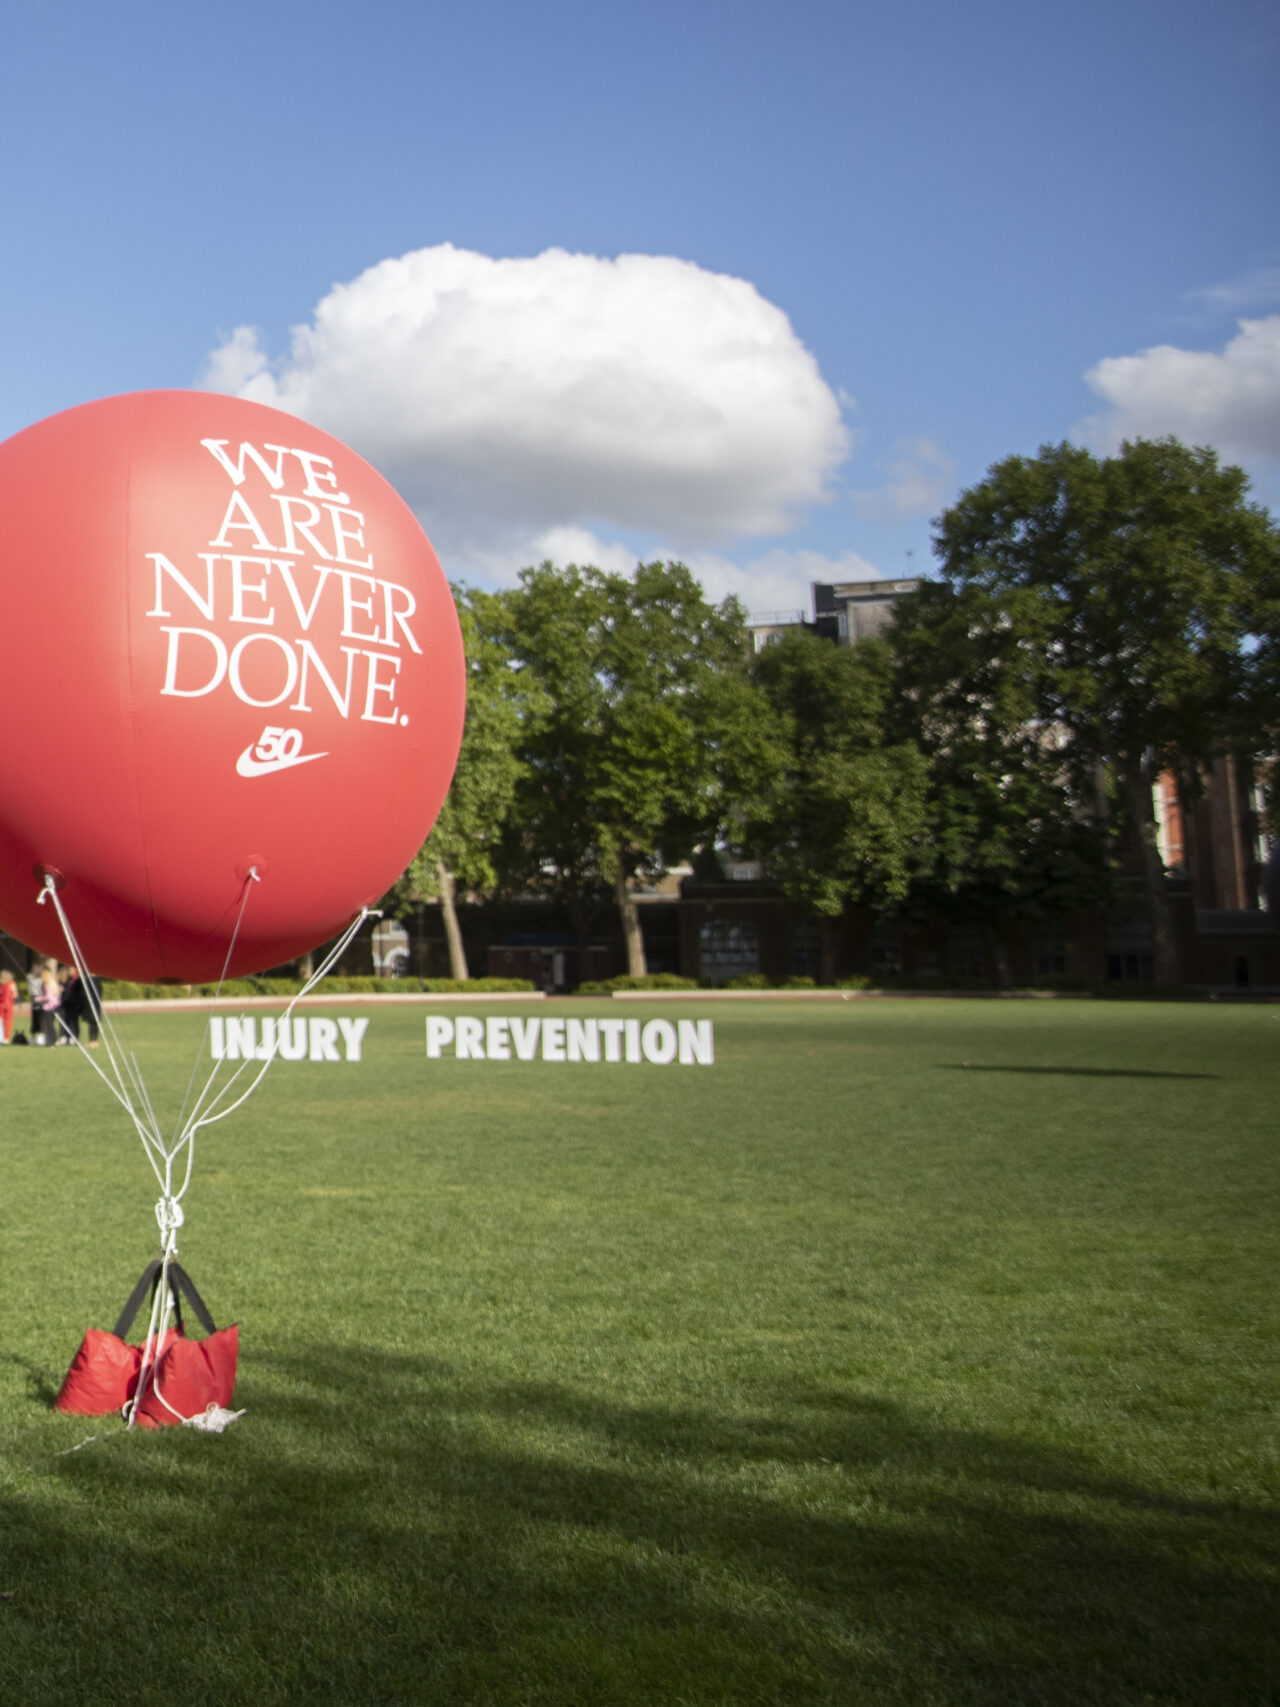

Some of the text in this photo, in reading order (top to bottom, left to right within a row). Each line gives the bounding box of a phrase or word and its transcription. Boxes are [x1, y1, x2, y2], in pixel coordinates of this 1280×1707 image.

[200, 438, 350, 505] WE
[208, 489, 374, 570] ARE
[145, 553, 423, 655] NEVER
[160, 625, 409, 727] DONE.
[255, 725, 303, 762] 50
[209, 1015, 715, 1065] INJURY PREVENTION
